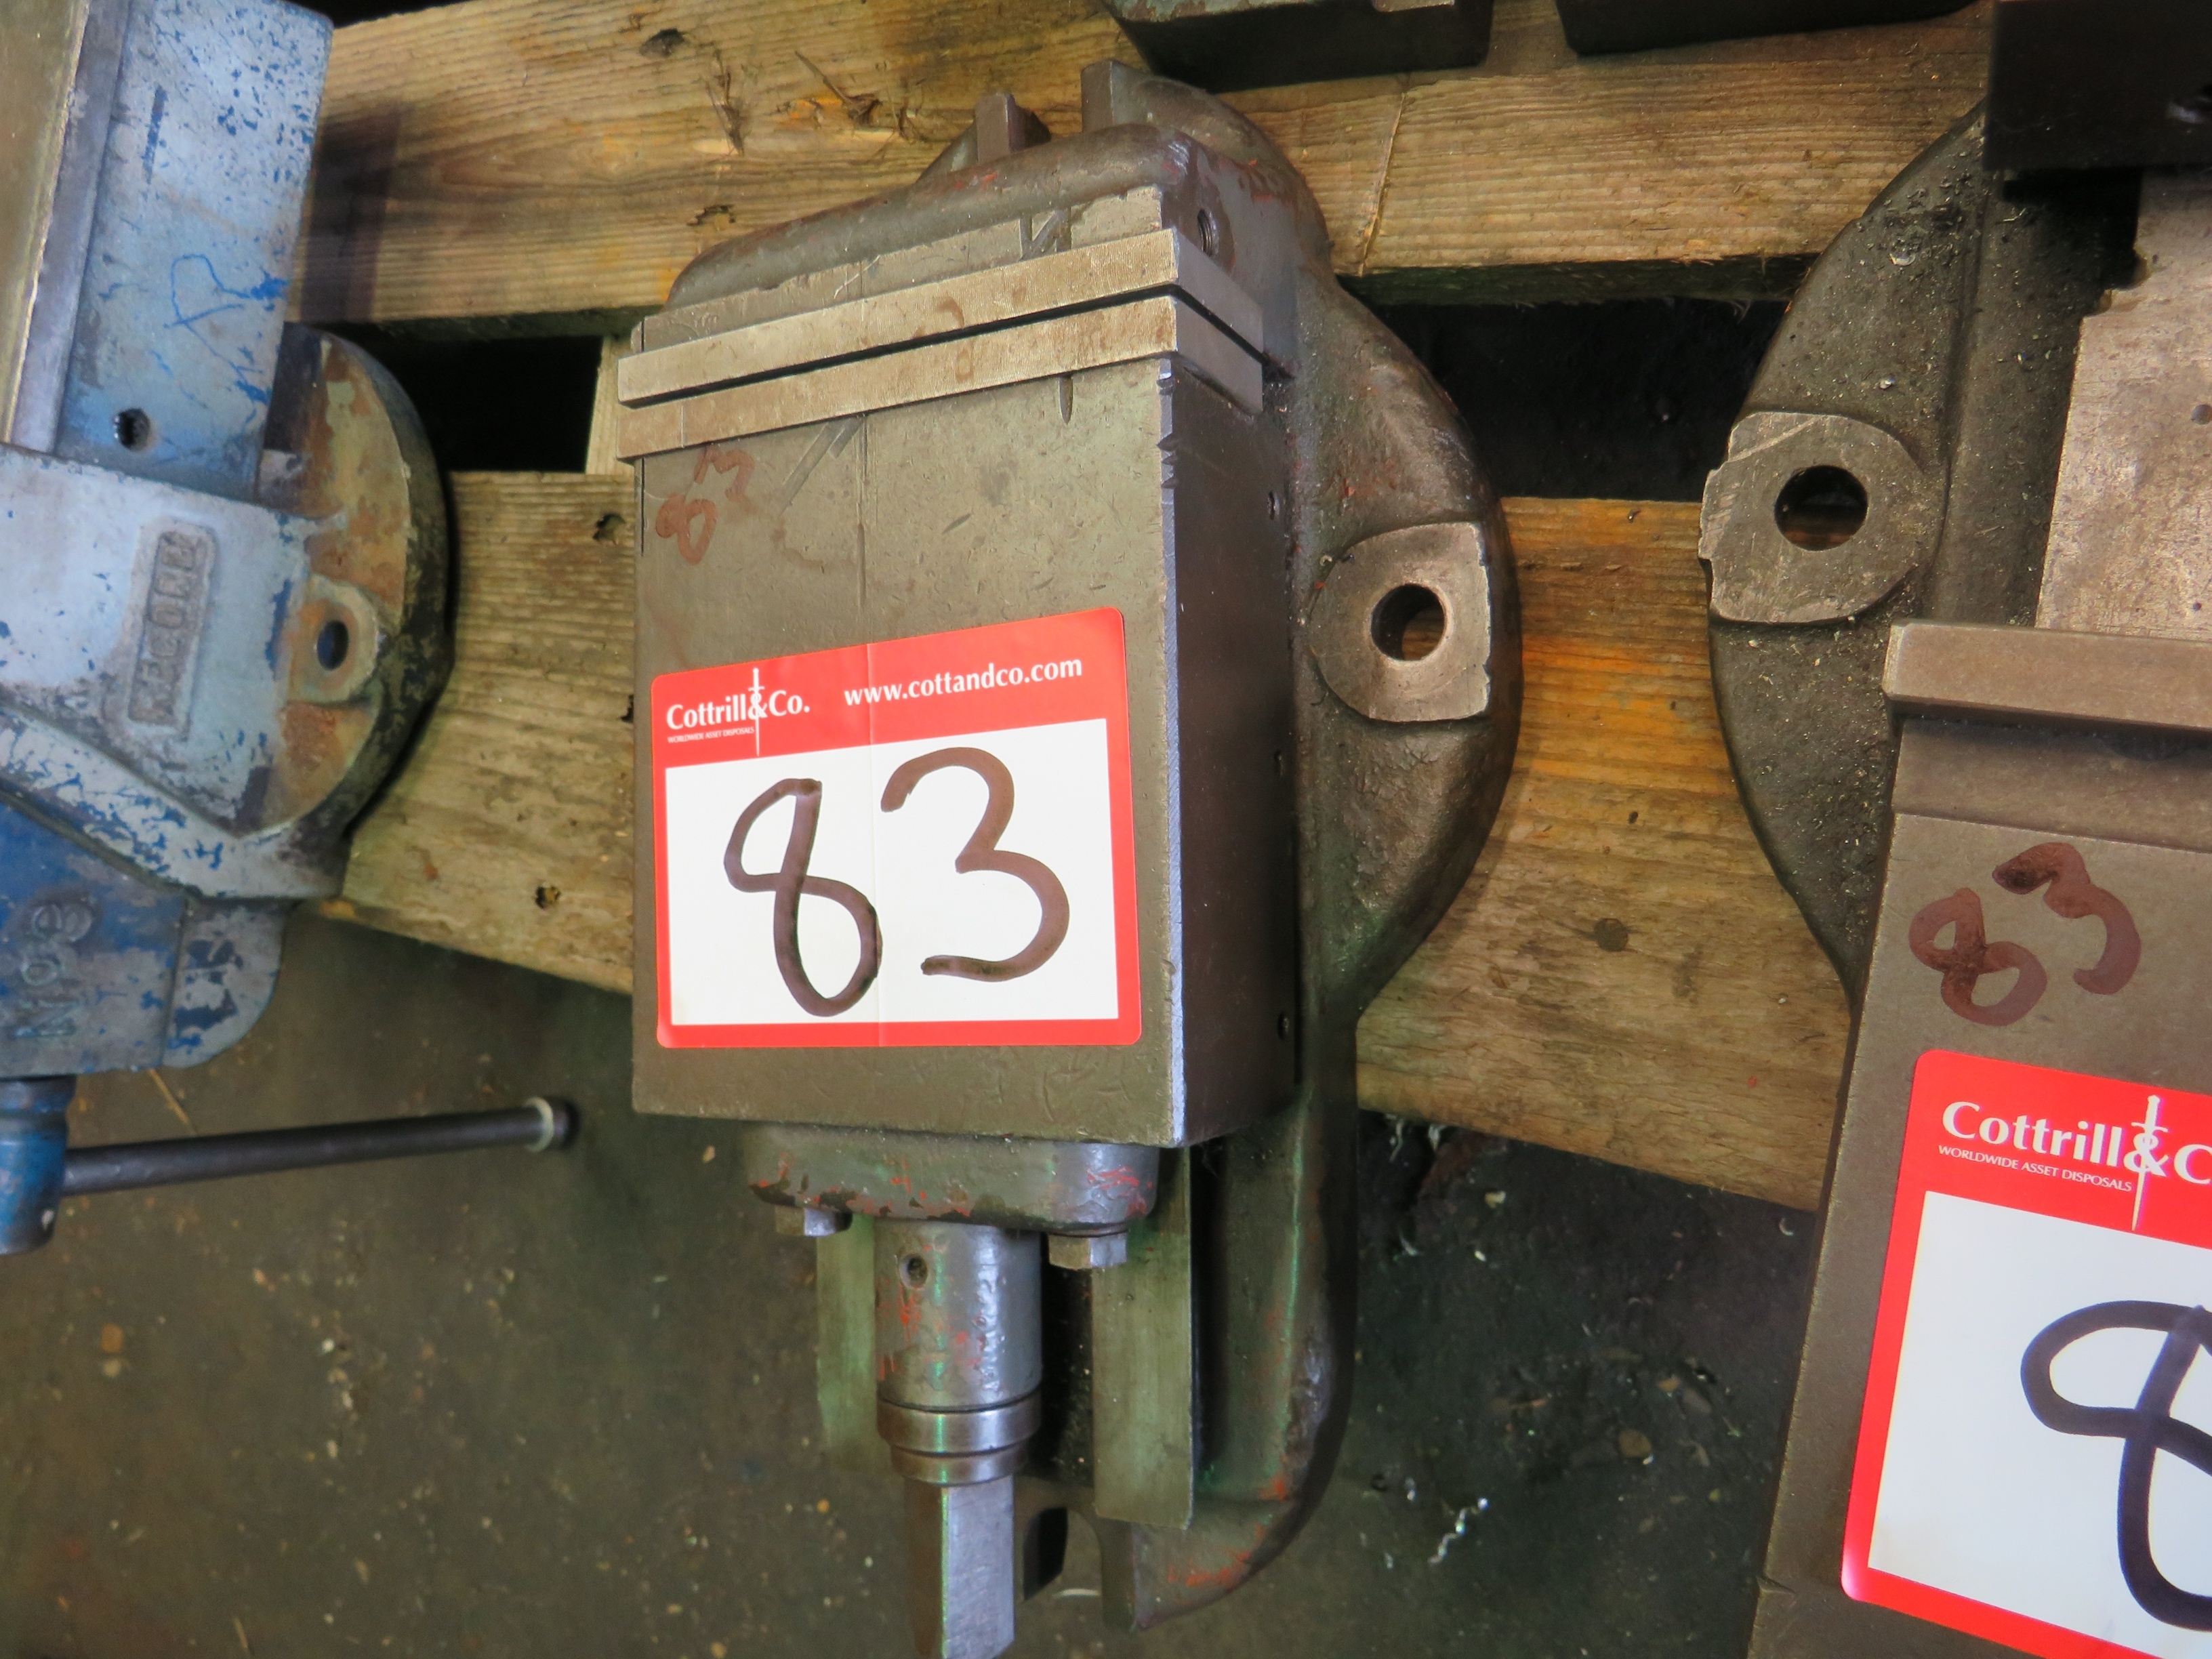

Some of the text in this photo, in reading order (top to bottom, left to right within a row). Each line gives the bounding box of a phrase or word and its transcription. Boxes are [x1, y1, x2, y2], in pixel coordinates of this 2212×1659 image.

[844, 659, 1082, 705] www.cottandco.com
[668, 726, 755, 743] WORLDWIDE ASSET DISPOSALS
[723, 746, 1071, 1017] 83
[1908, 842, 2142, 1027] 83
[1938, 1145, 2132, 1192] WORLDWIDE ASSET DISPOSALS
